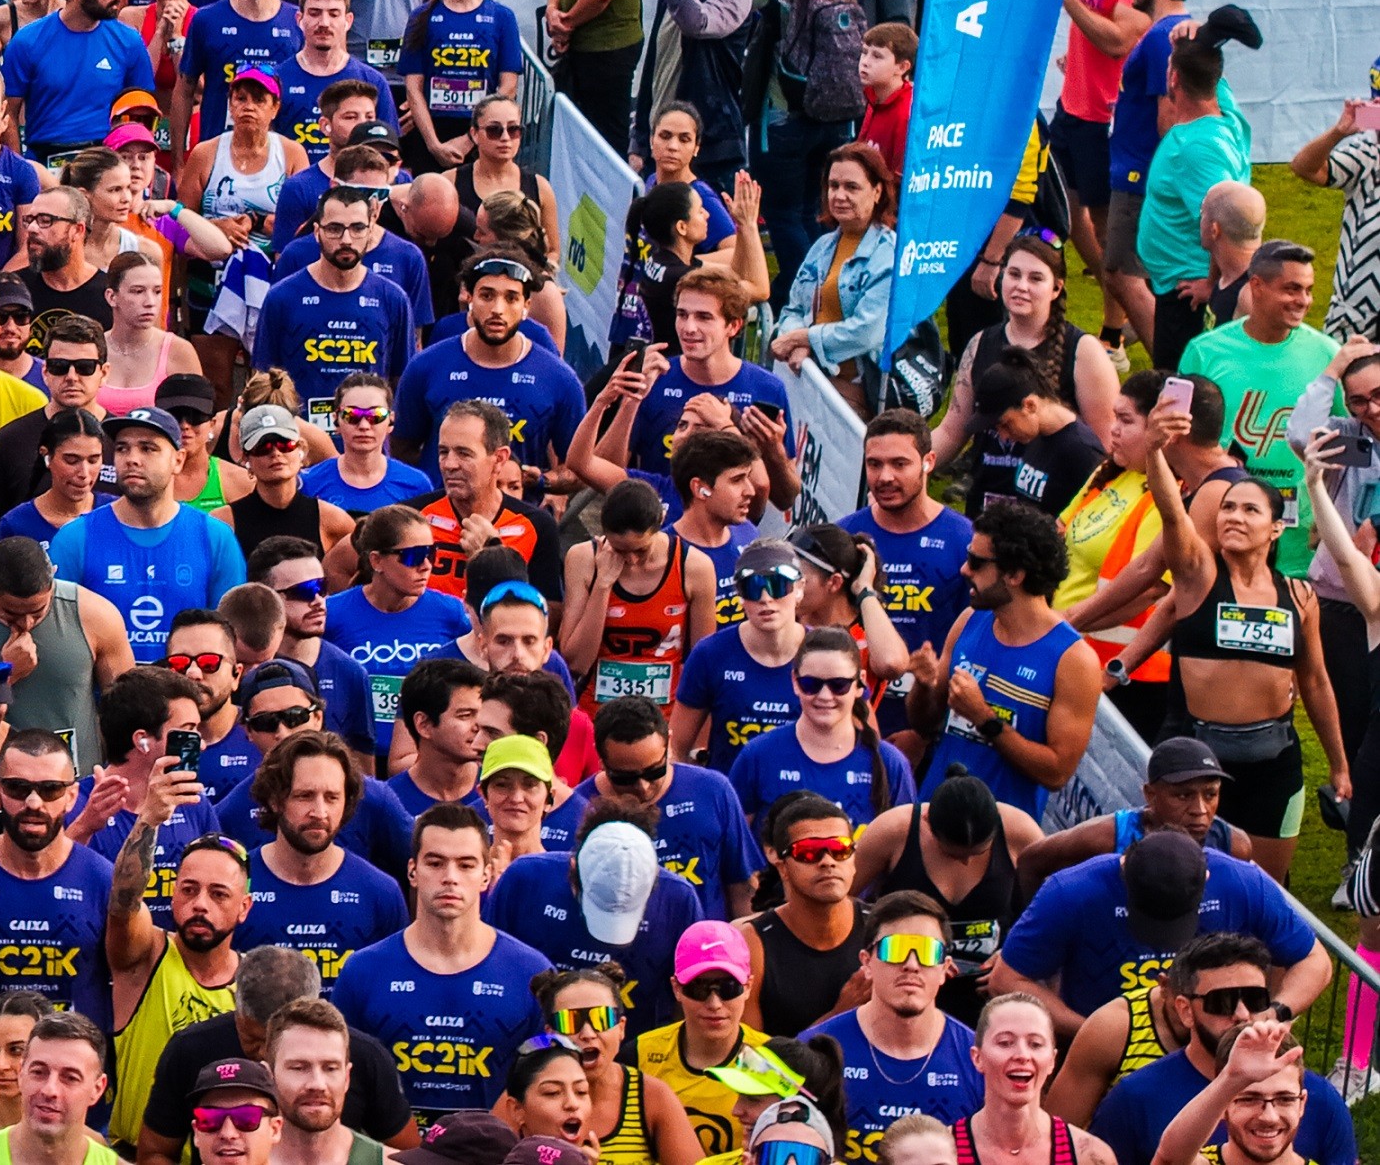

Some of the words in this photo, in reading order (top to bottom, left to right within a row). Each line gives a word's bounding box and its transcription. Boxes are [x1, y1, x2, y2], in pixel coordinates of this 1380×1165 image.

[449, 32, 473, 40] CAIXA
[244, 49, 269, 57] CAIXA
[432, 47, 490, 67] SC21K
[443, 89, 474, 103] 5011
[927, 122, 966, 150] PACE
[941, 164, 993, 189] 5min
[914, 239, 959, 260] CORRE
[328, 320, 357, 329] CAIXA
[305, 339, 376, 363] SC21K
[1251, 468, 1295, 480] UNNING
[882, 563, 912, 573] CAIXA
[1238, 622, 1274, 642] 754
[602, 625, 682, 656] GPA
[352, 639, 440, 664] dobr
[646, 665, 668, 676] 15K
[724, 670, 744, 681] RVB
[612, 678, 655, 696] 3351
[754, 701, 789, 713] CAIXA
[780, 770, 800, 781] RVB
[252, 891, 275, 903] RVB
[544, 904, 567, 921] RVB
[10, 920, 49, 931] CAIXA
[287, 924, 326, 934] CAIXA
[571, 949, 611, 963] CAIXA
[390, 980, 415, 992] RVB
[426, 1016, 464, 1028] CAIXA
[392, 1041, 493, 1076] SC21K
[844, 1067, 868, 1079] RVB
